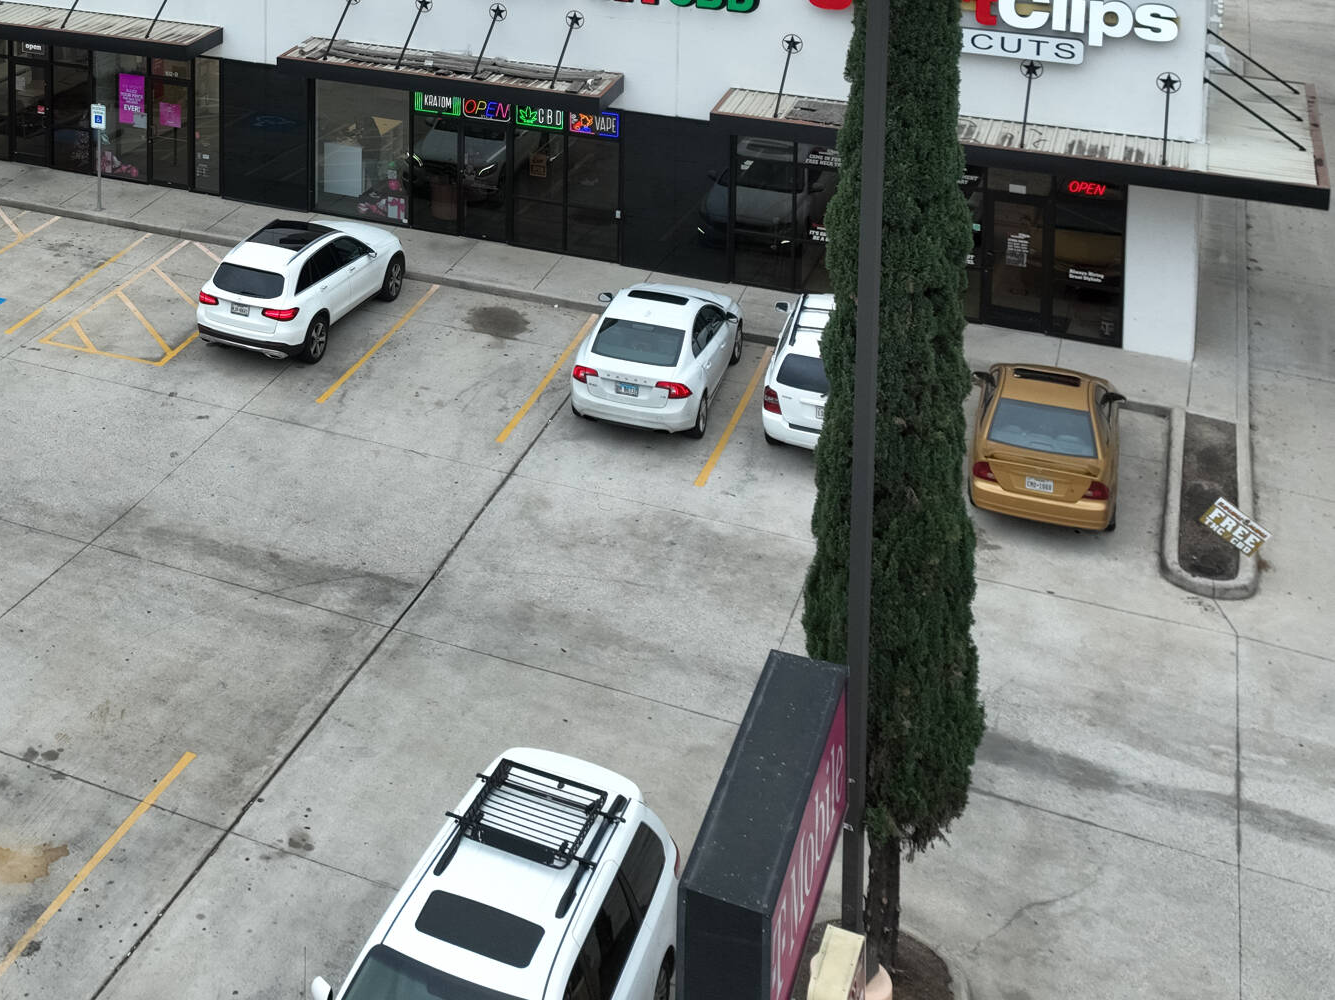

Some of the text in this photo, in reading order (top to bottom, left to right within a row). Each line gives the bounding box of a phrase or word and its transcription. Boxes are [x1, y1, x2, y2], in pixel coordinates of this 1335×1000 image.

[424, 93, 452, 109] KRATOM
[464, 99, 510, 118] OPEN
[538, 108, 562, 126] CBD
[594, 115, 616, 133] VAPE
[1068, 180, 1106, 196] OPEN
[1208, 507, 1261, 548] FREE
